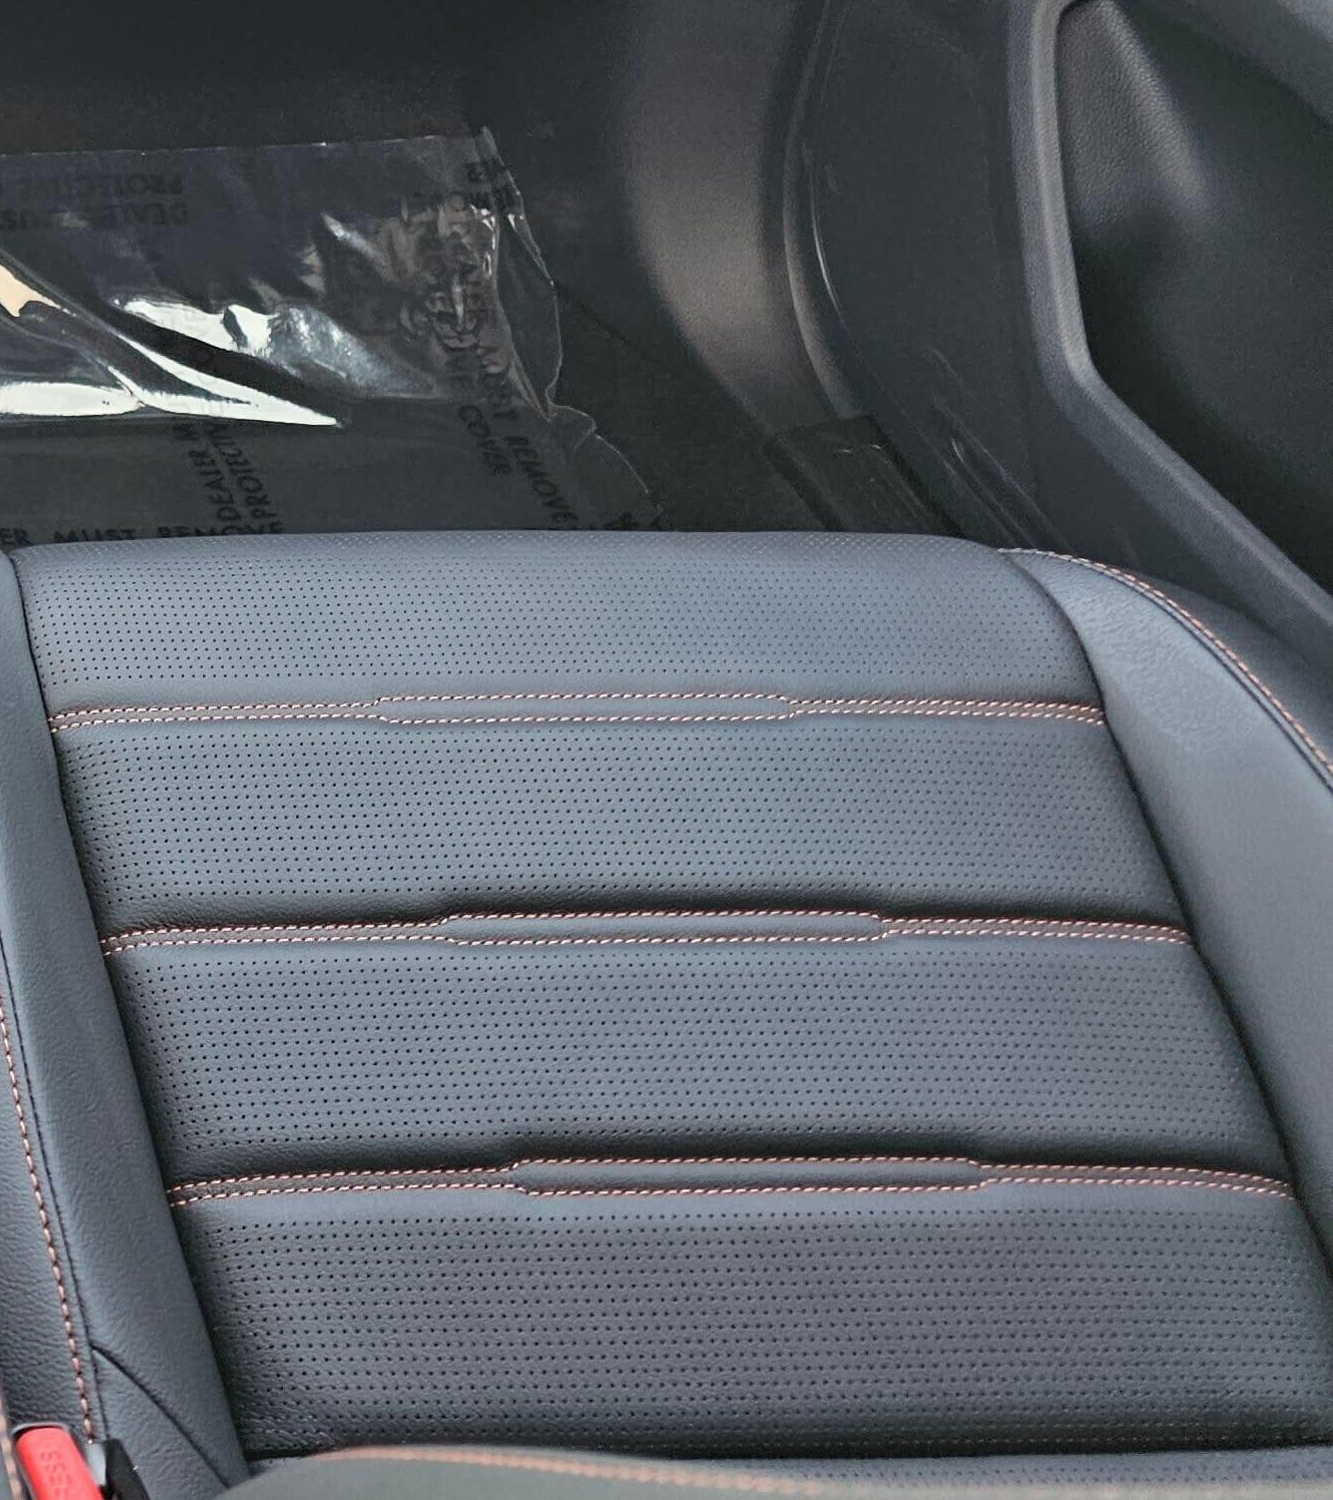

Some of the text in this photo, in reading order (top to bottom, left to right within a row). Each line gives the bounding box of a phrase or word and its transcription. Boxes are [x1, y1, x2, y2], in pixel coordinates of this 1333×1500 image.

[458, 405, 513, 477] COVER
[188, 449, 241, 522] DEALER
[504, 436, 580, 524] REMOVE
